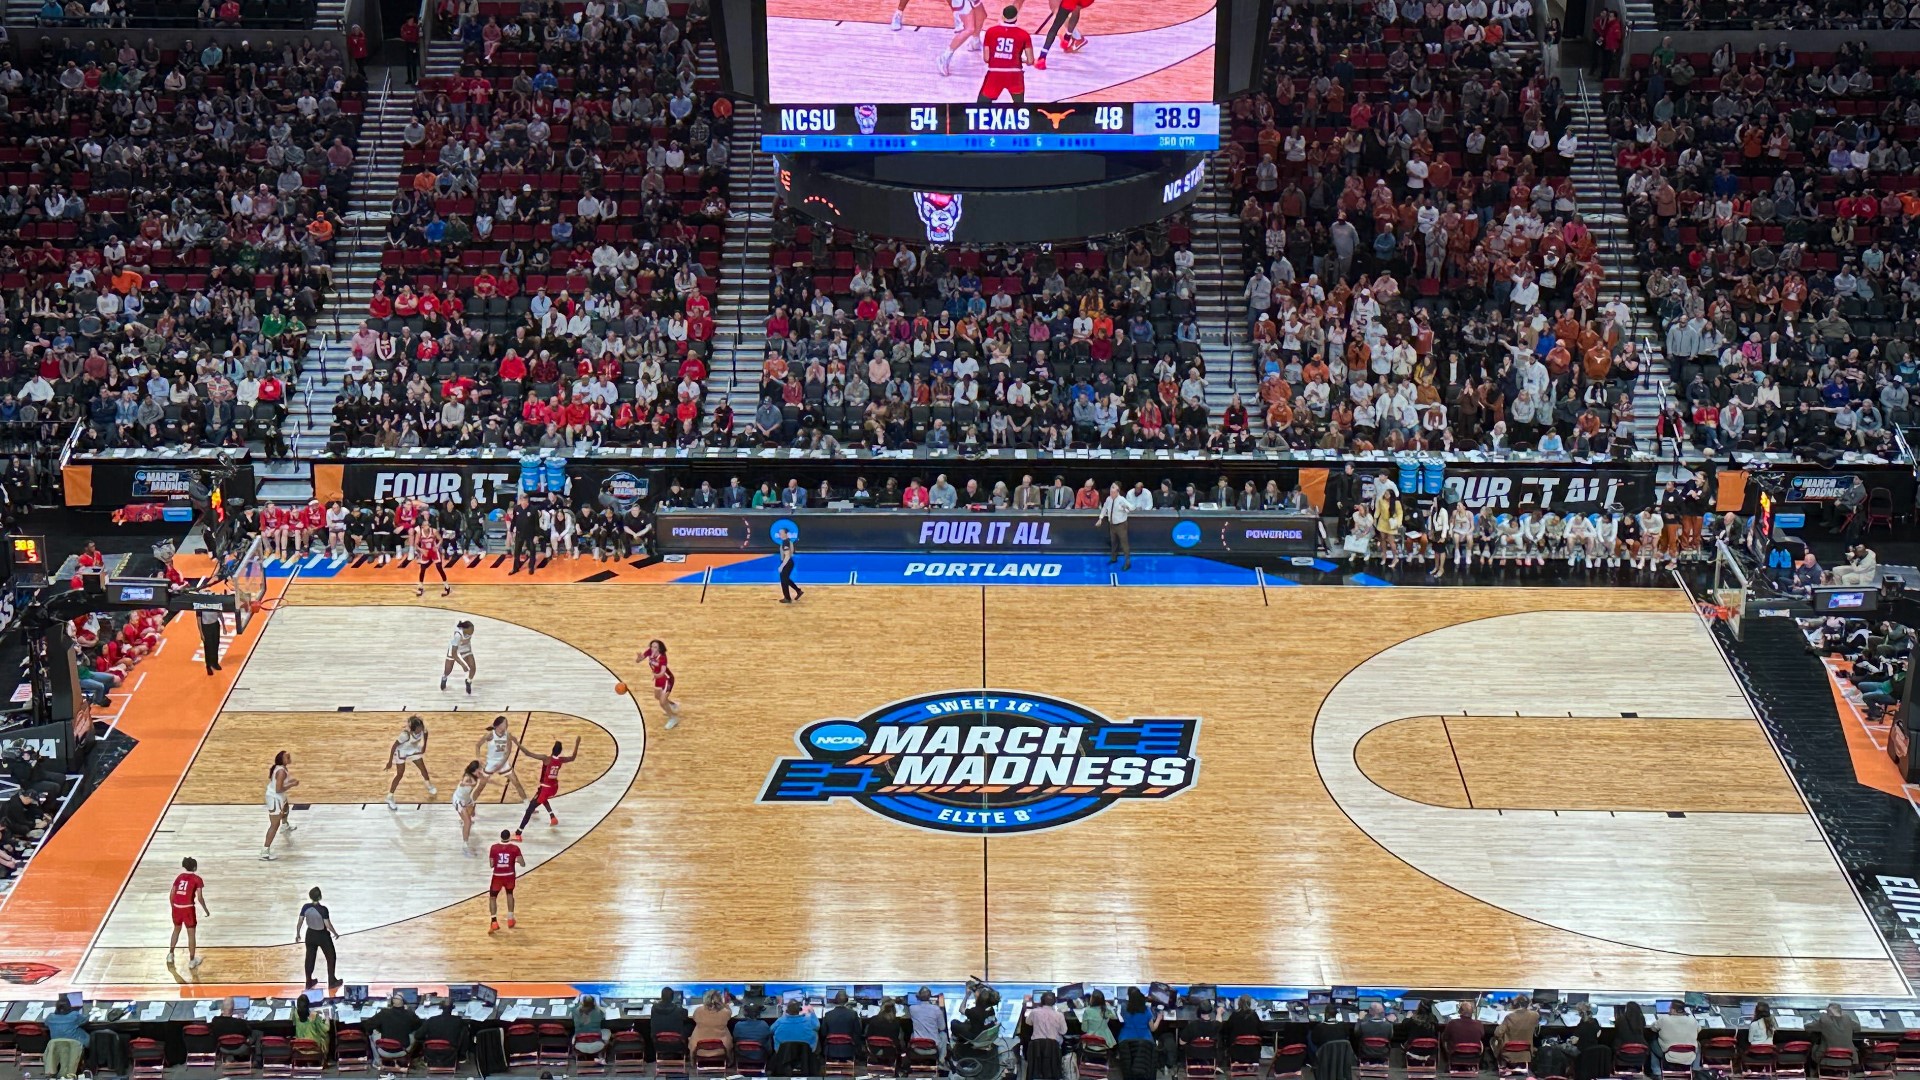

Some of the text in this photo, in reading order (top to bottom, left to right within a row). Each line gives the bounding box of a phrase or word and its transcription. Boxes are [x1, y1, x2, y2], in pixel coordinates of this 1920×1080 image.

[995, 37, 1015, 53] 35
[781, 107, 938, 131] NCSU 54
[965, 106, 1124, 130] TEXAS 48
[1154, 107, 1201, 129] 38.9
[799, 137, 806, 147] 4
[847, 136, 853, 147] 4
[989, 136, 996, 147] 2
[1178, 136, 1195, 148] QTR
[1163, 178, 1182, 203] NC
[150, 481, 190, 492] MADNES
[374, 472, 509, 504] FOUR IT
[671, 527, 729, 537] POWERADE
[919, 521, 1052, 545] FOUR IT ALL
[1245, 529, 1303, 539] POWERADE
[27, 549, 37, 562] 5
[903, 562, 1063, 577] PORTLAND
[925, 698, 1034, 715] SWEET 16
[815, 736, 866, 745] NCAA
[868, 725, 1084, 754] MARCH
[891, 755, 1187, 786] MADNESS
[937, 808, 1031, 824] ELITE 8
[497, 853, 510, 864] 35
[178, 880, 189, 891] 21
